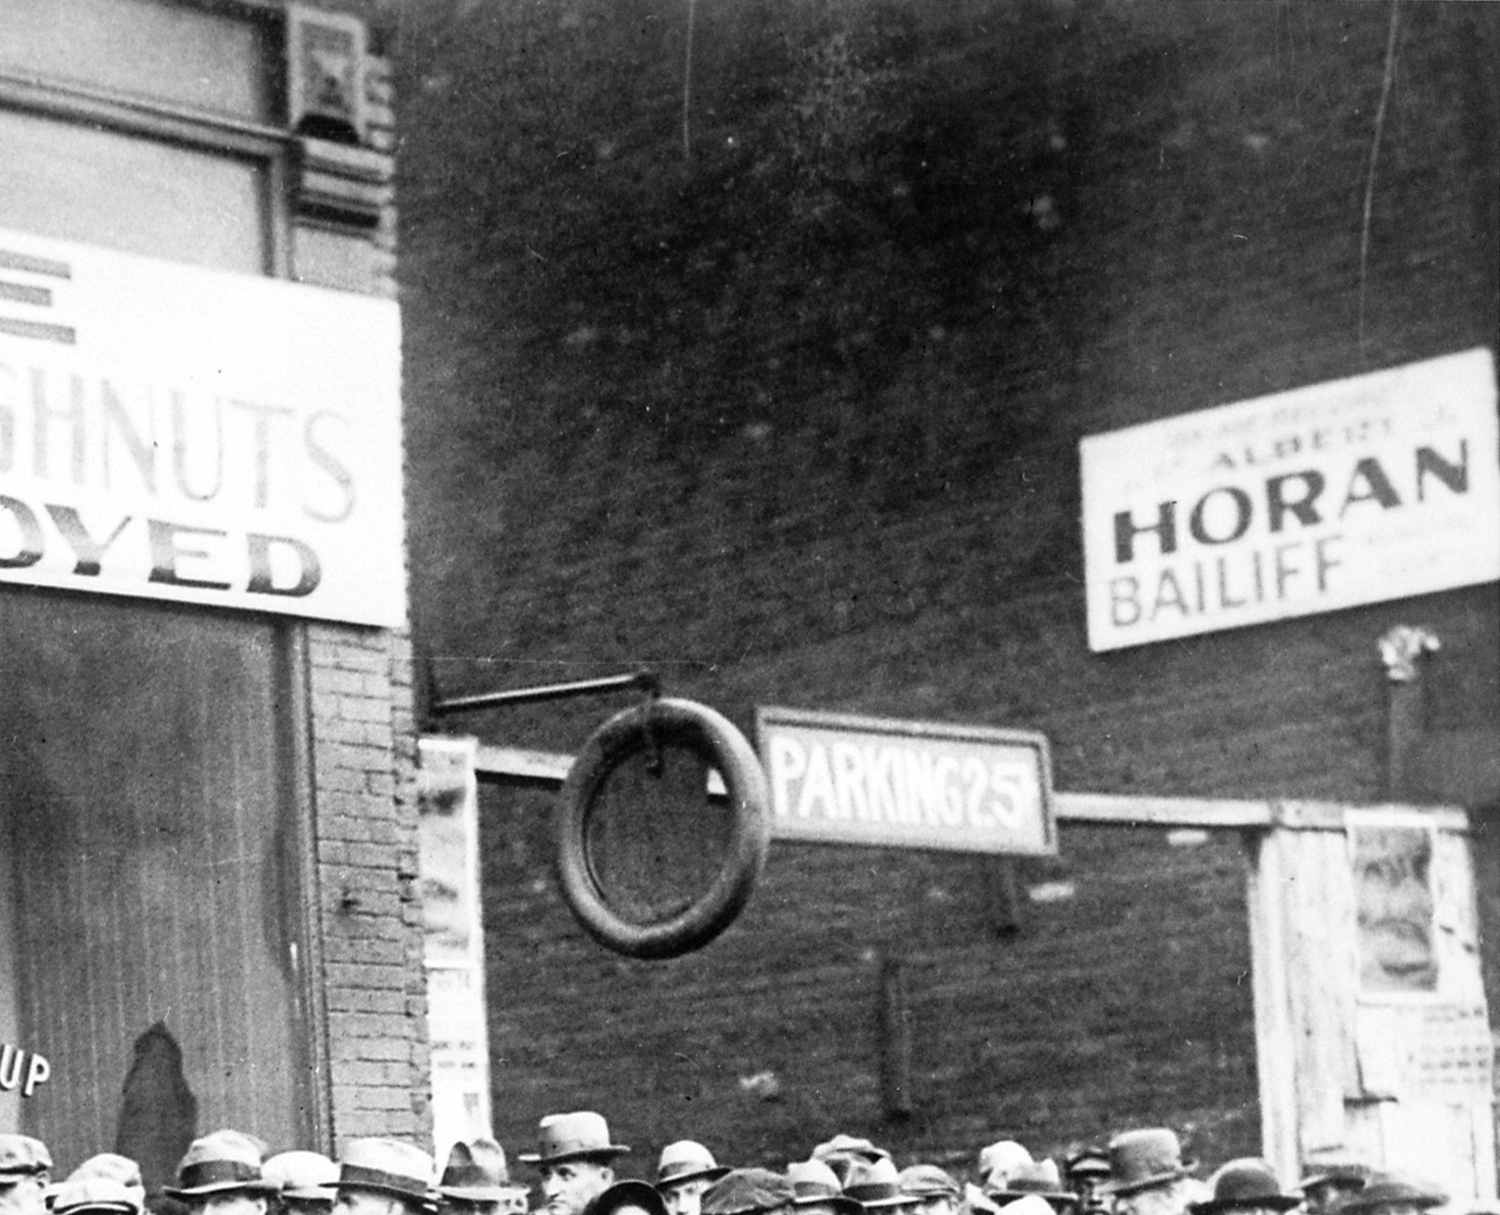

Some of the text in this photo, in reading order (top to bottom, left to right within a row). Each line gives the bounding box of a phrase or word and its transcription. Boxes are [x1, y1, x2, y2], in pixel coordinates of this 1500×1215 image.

[1112, 437, 1470, 565] HORAN
[1107, 533, 1344, 629] BAILIFF
[768, 735, 964, 828] PARKING
